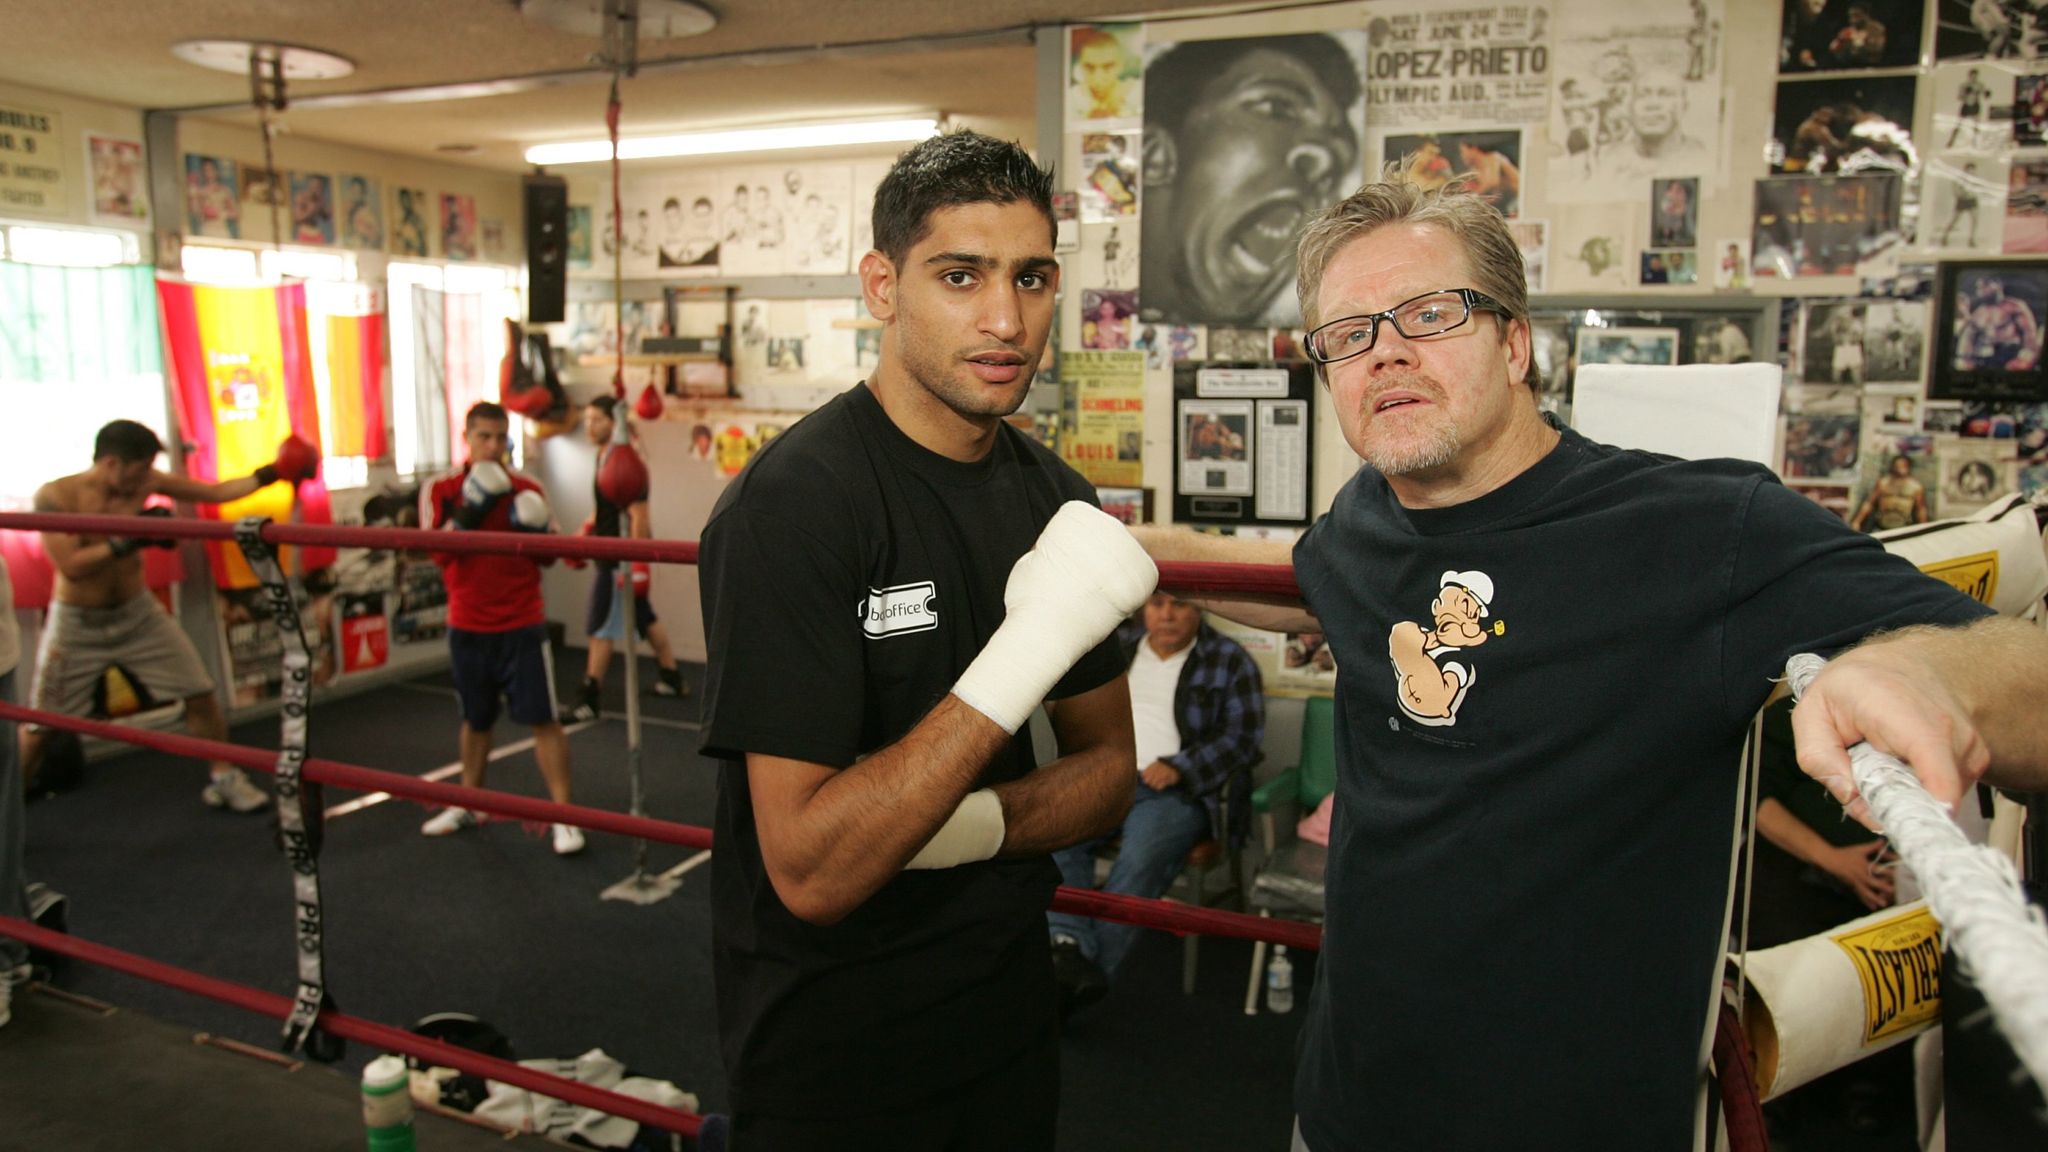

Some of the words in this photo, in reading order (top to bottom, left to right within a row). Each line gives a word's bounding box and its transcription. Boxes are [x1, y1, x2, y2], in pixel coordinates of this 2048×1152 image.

[1392, 28, 1417, 41] SAT
[1430, 25, 1463, 41] JUNE
[1471, 24, 1490, 39] 24
[1452, 46, 1547, 76] PRIETO
[1451, 83, 1491, 101] AUD.
[1066, 443, 1114, 460] LOUIS
[299, 901, 319, 952] PRO
